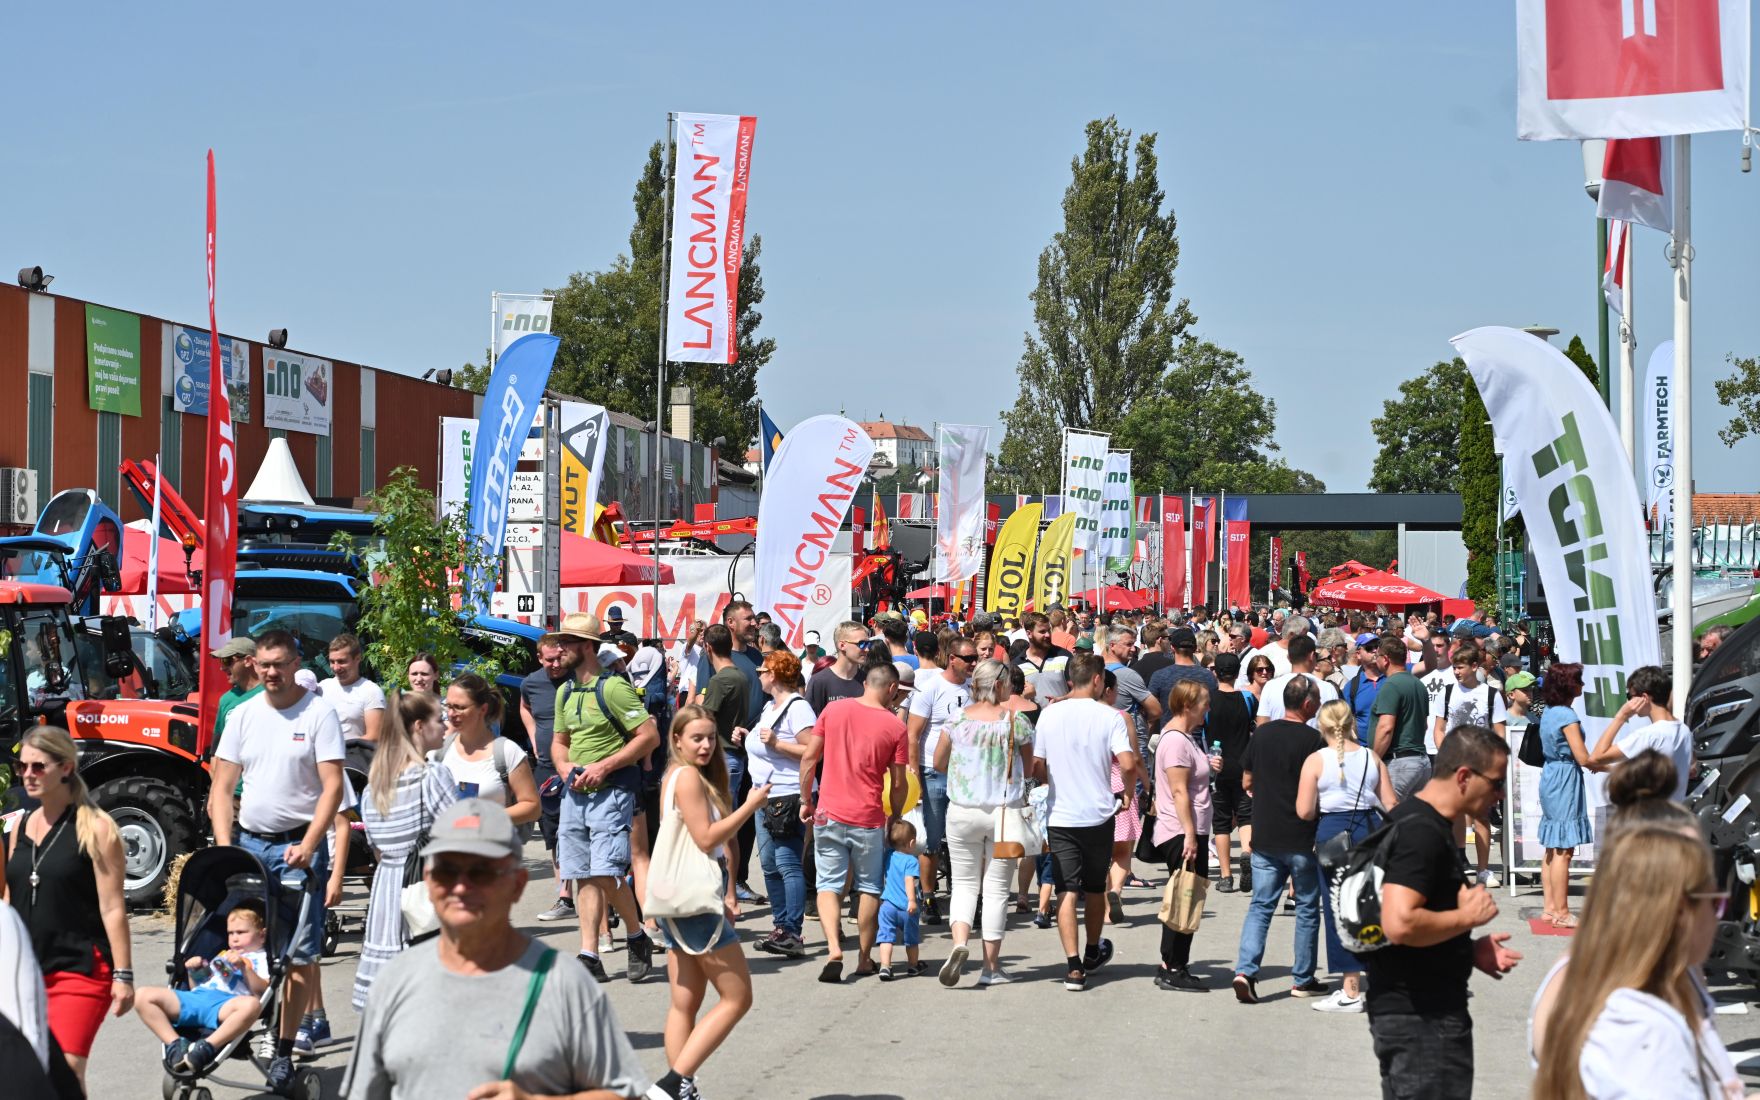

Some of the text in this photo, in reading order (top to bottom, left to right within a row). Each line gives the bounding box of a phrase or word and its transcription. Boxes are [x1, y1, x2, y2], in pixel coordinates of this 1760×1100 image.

[736, 135, 750, 192] LANCMAN
[683, 154, 720, 349] LANCMAN
[727, 219, 741, 274] LANCMAN
[502, 313, 549, 332] ino
[266, 358, 301, 399] ino
[1656, 376, 1670, 458] FARMTECH
[1071, 455, 1104, 471] ino
[515, 474, 532, 482] Hala
[1105, 471, 1128, 483] no
[564, 466, 579, 533] MUT
[1069, 485, 1102, 502] ino
[1102, 499, 1129, 511] ino
[1075, 517, 1099, 532] no
[1165, 512, 1181, 523] SIP
[1102, 527, 1129, 538] ino
[1230, 533, 1246, 542] SIP
[1043, 555, 1065, 612] JOL
[76, 714, 129, 725] GOLDONI
